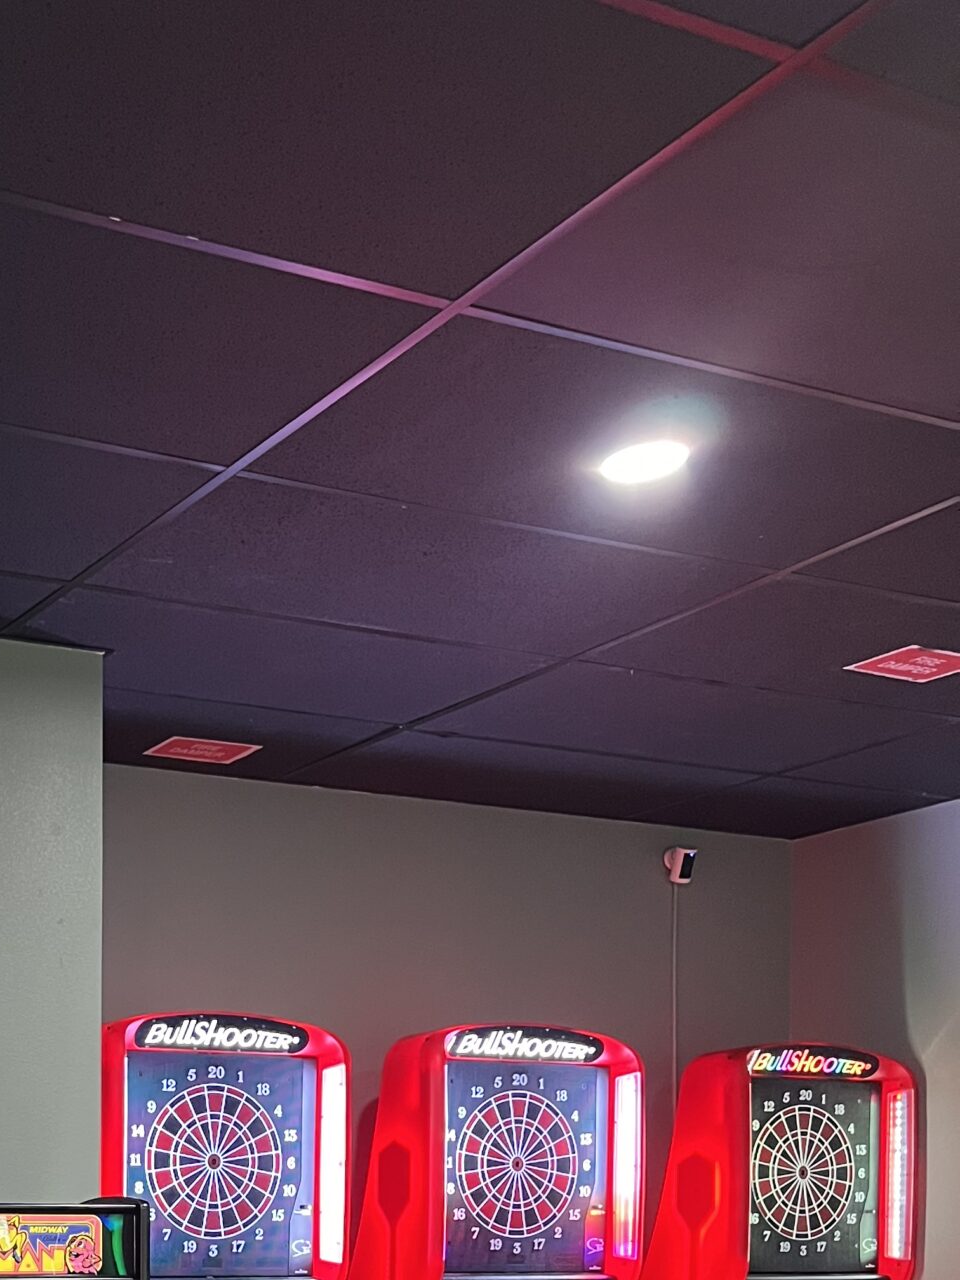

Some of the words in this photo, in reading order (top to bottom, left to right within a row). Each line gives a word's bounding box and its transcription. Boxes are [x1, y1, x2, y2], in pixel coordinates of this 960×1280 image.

[188, 1069, 196, 1080] 5
[208, 1067, 224, 1078] 20
[238, 1072, 243, 1082] 1
[494, 1077, 502, 1088] 5
[512, 1074, 527, 1085] 20
[539, 1079, 544, 1089] 1
[162, 1080, 176, 1091] 12
[257, 1084, 270, 1095] 18
[471, 1087, 484, 1098] 12
[557, 1090, 567, 1101] 18
[783, 1092, 790, 1103] 5
[800, 1090, 812, 1100] 20
[822, 1094, 826, 1104] 1
[147, 1101, 156, 1113] 9
[274, 1105, 282, 1116] 4
[764, 1101, 775, 1112] 12
[835, 1105, 845, 1115] 18
[458, 1107, 466, 1118] 9
[571, 1111, 578, 1121] 4
[131, 1125, 144, 1137] 14
[753, 1120, 760, 1131] 9
[848, 1124, 854, 1133] 4
[284, 1130, 297, 1141] 13
[580, 1134, 592, 1145] 13
[856, 1145, 866, 1155] 13
[130, 1154, 141, 1165] 11
[287, 1158, 295, 1169] 6
[583, 1160, 591, 1170] 6
[858, 1169, 865, 1178] 6
[135, 1182, 144, 1193] 8
[283, 1185, 296, 1196] 10
[579, 1187, 590, 1197] 10
[855, 1193, 865, 1202] 10
[272, 1210, 284, 1221] 15
[453, 1208, 465, 1220] 16
[569, 1209, 580, 1220] 15
[847, 1214, 857, 1224] 15
[29, 1225, 69, 1235] MIDWAY
[163, 1229, 171, 1240] 7
[255, 1229, 264, 1240] 2
[471, 1227, 479, 1238] 7
[554, 1227, 562, 1238] 2
[763, 1231, 770, 1241] 7
[834, 1231, 840, 1241] 2
[183, 1241, 196, 1252] 19
[232, 1240, 245, 1252] 17
[490, 1239, 502, 1250] 19
[513, 1243, 521, 1253] 3
[534, 1238, 545, 1250] 17
[780, 1242, 791, 1252] 19
[817, 1241, 826, 1252] 17
[209, 1245, 218, 1257] 3
[800, 1246, 807, 1256] 3
